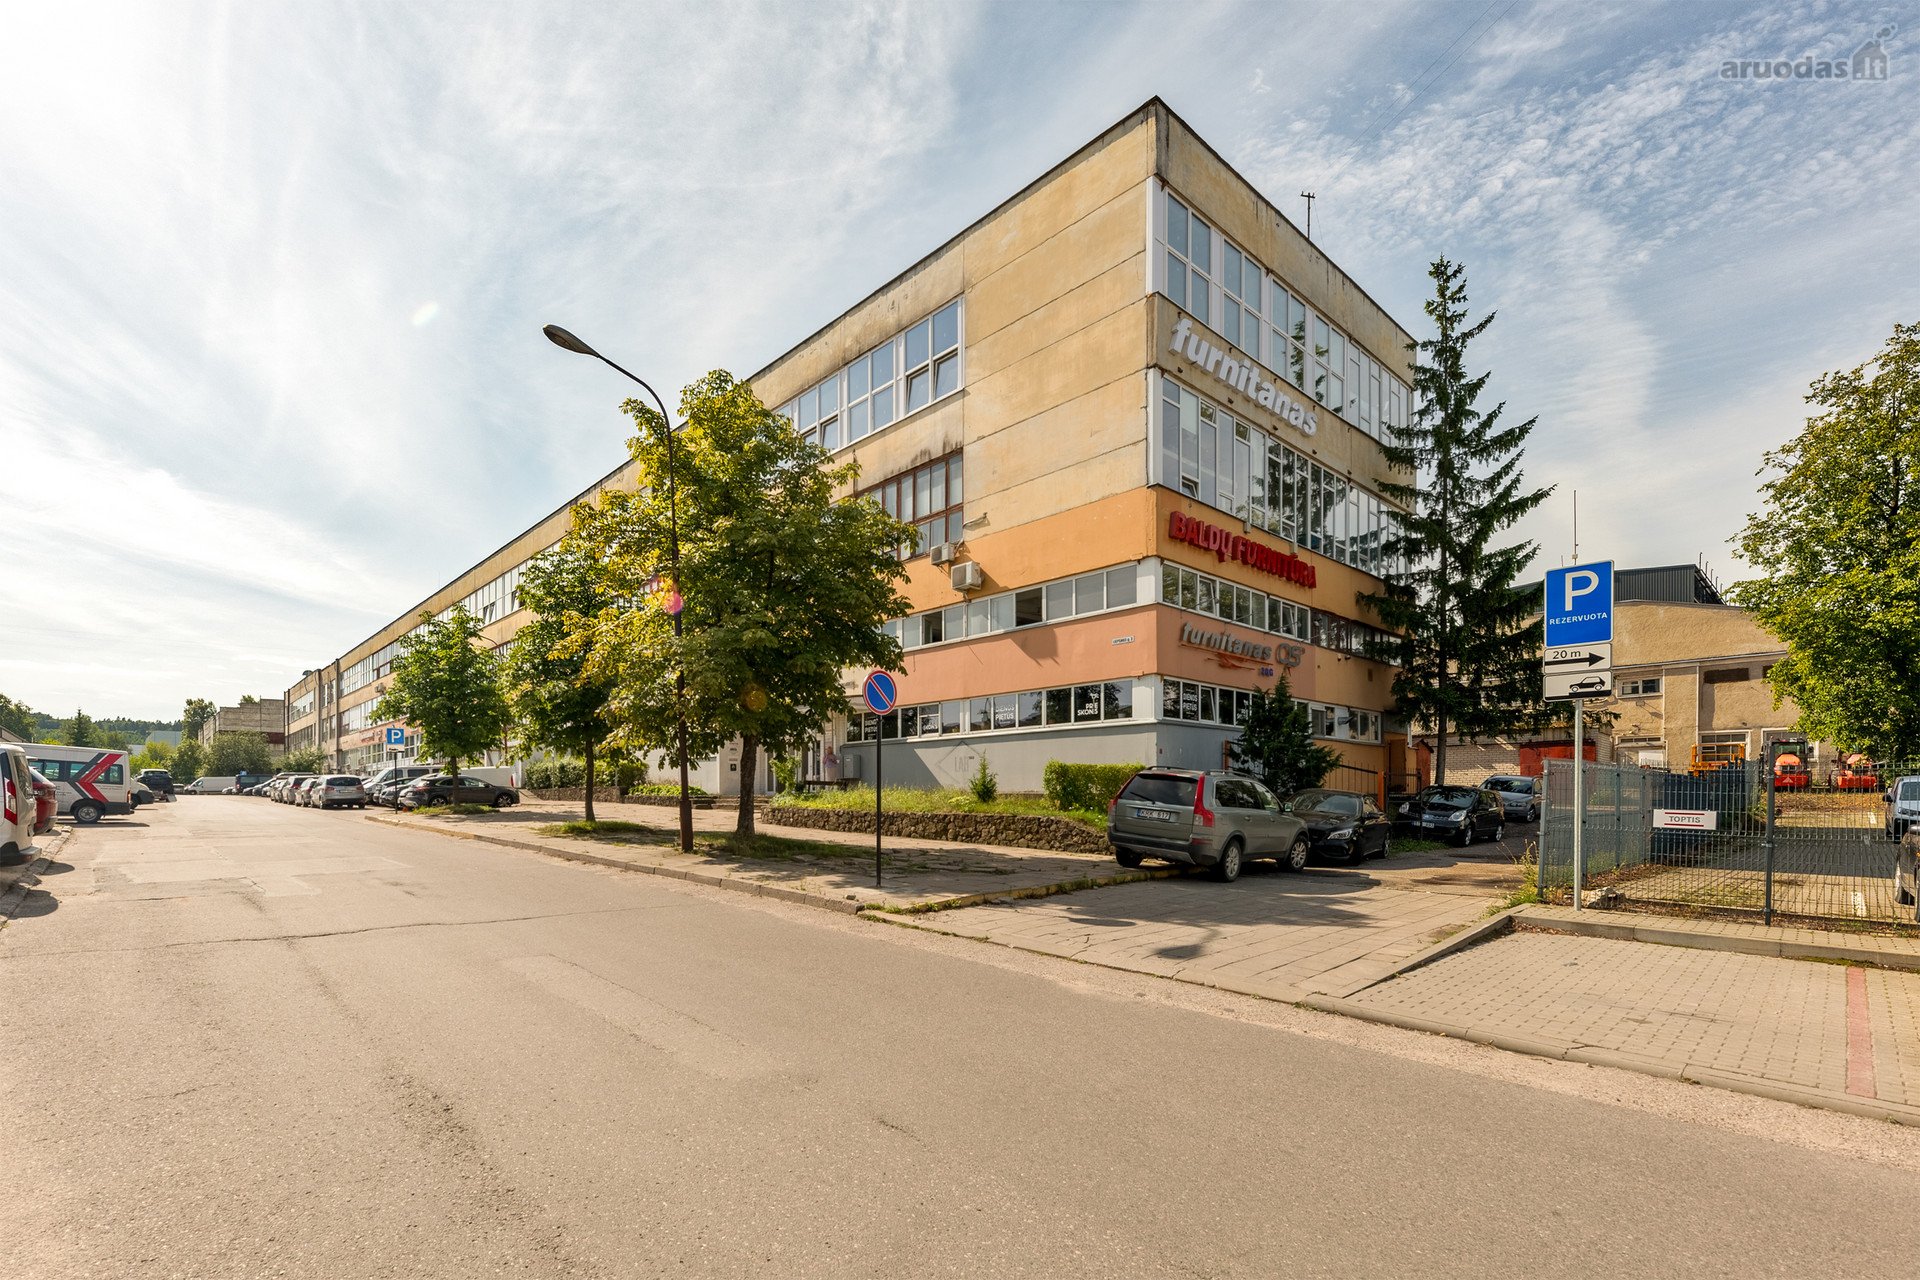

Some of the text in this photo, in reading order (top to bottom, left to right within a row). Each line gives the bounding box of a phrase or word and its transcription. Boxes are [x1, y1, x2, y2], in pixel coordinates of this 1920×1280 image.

[1168, 317, 1318, 437] furnitanas
[1169, 510, 1233, 563] BALDŲ
[1564, 569, 1599, 612] P
[1549, 612, 1608, 625] REZERVUOTA
[1181, 621, 1273, 661] furnitanas
[1552, 649, 1581, 660] 20 m
[391, 729, 402, 743] P
[1668, 815, 1701, 824] TOPTIS
